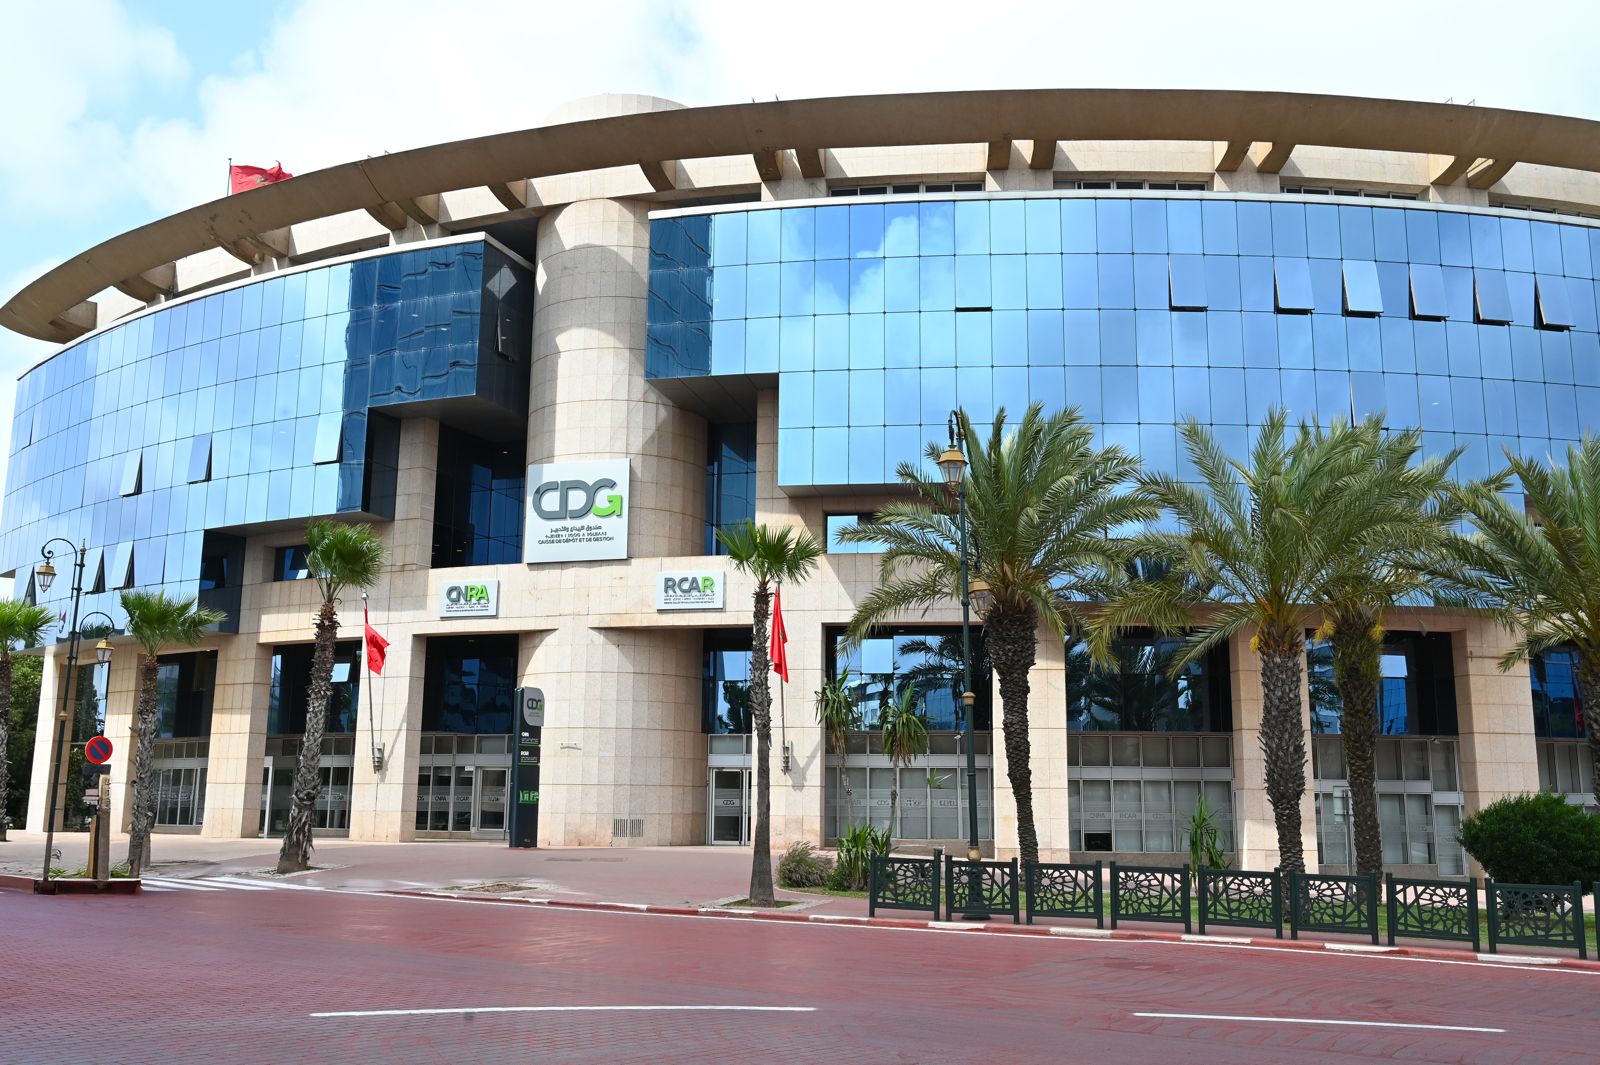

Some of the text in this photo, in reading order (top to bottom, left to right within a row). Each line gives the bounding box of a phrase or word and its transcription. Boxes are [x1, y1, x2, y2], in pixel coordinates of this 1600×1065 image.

[532, 478, 623, 520] CDG
[664, 576, 714, 593] RCAR
[446, 585, 489, 602] CNRA
